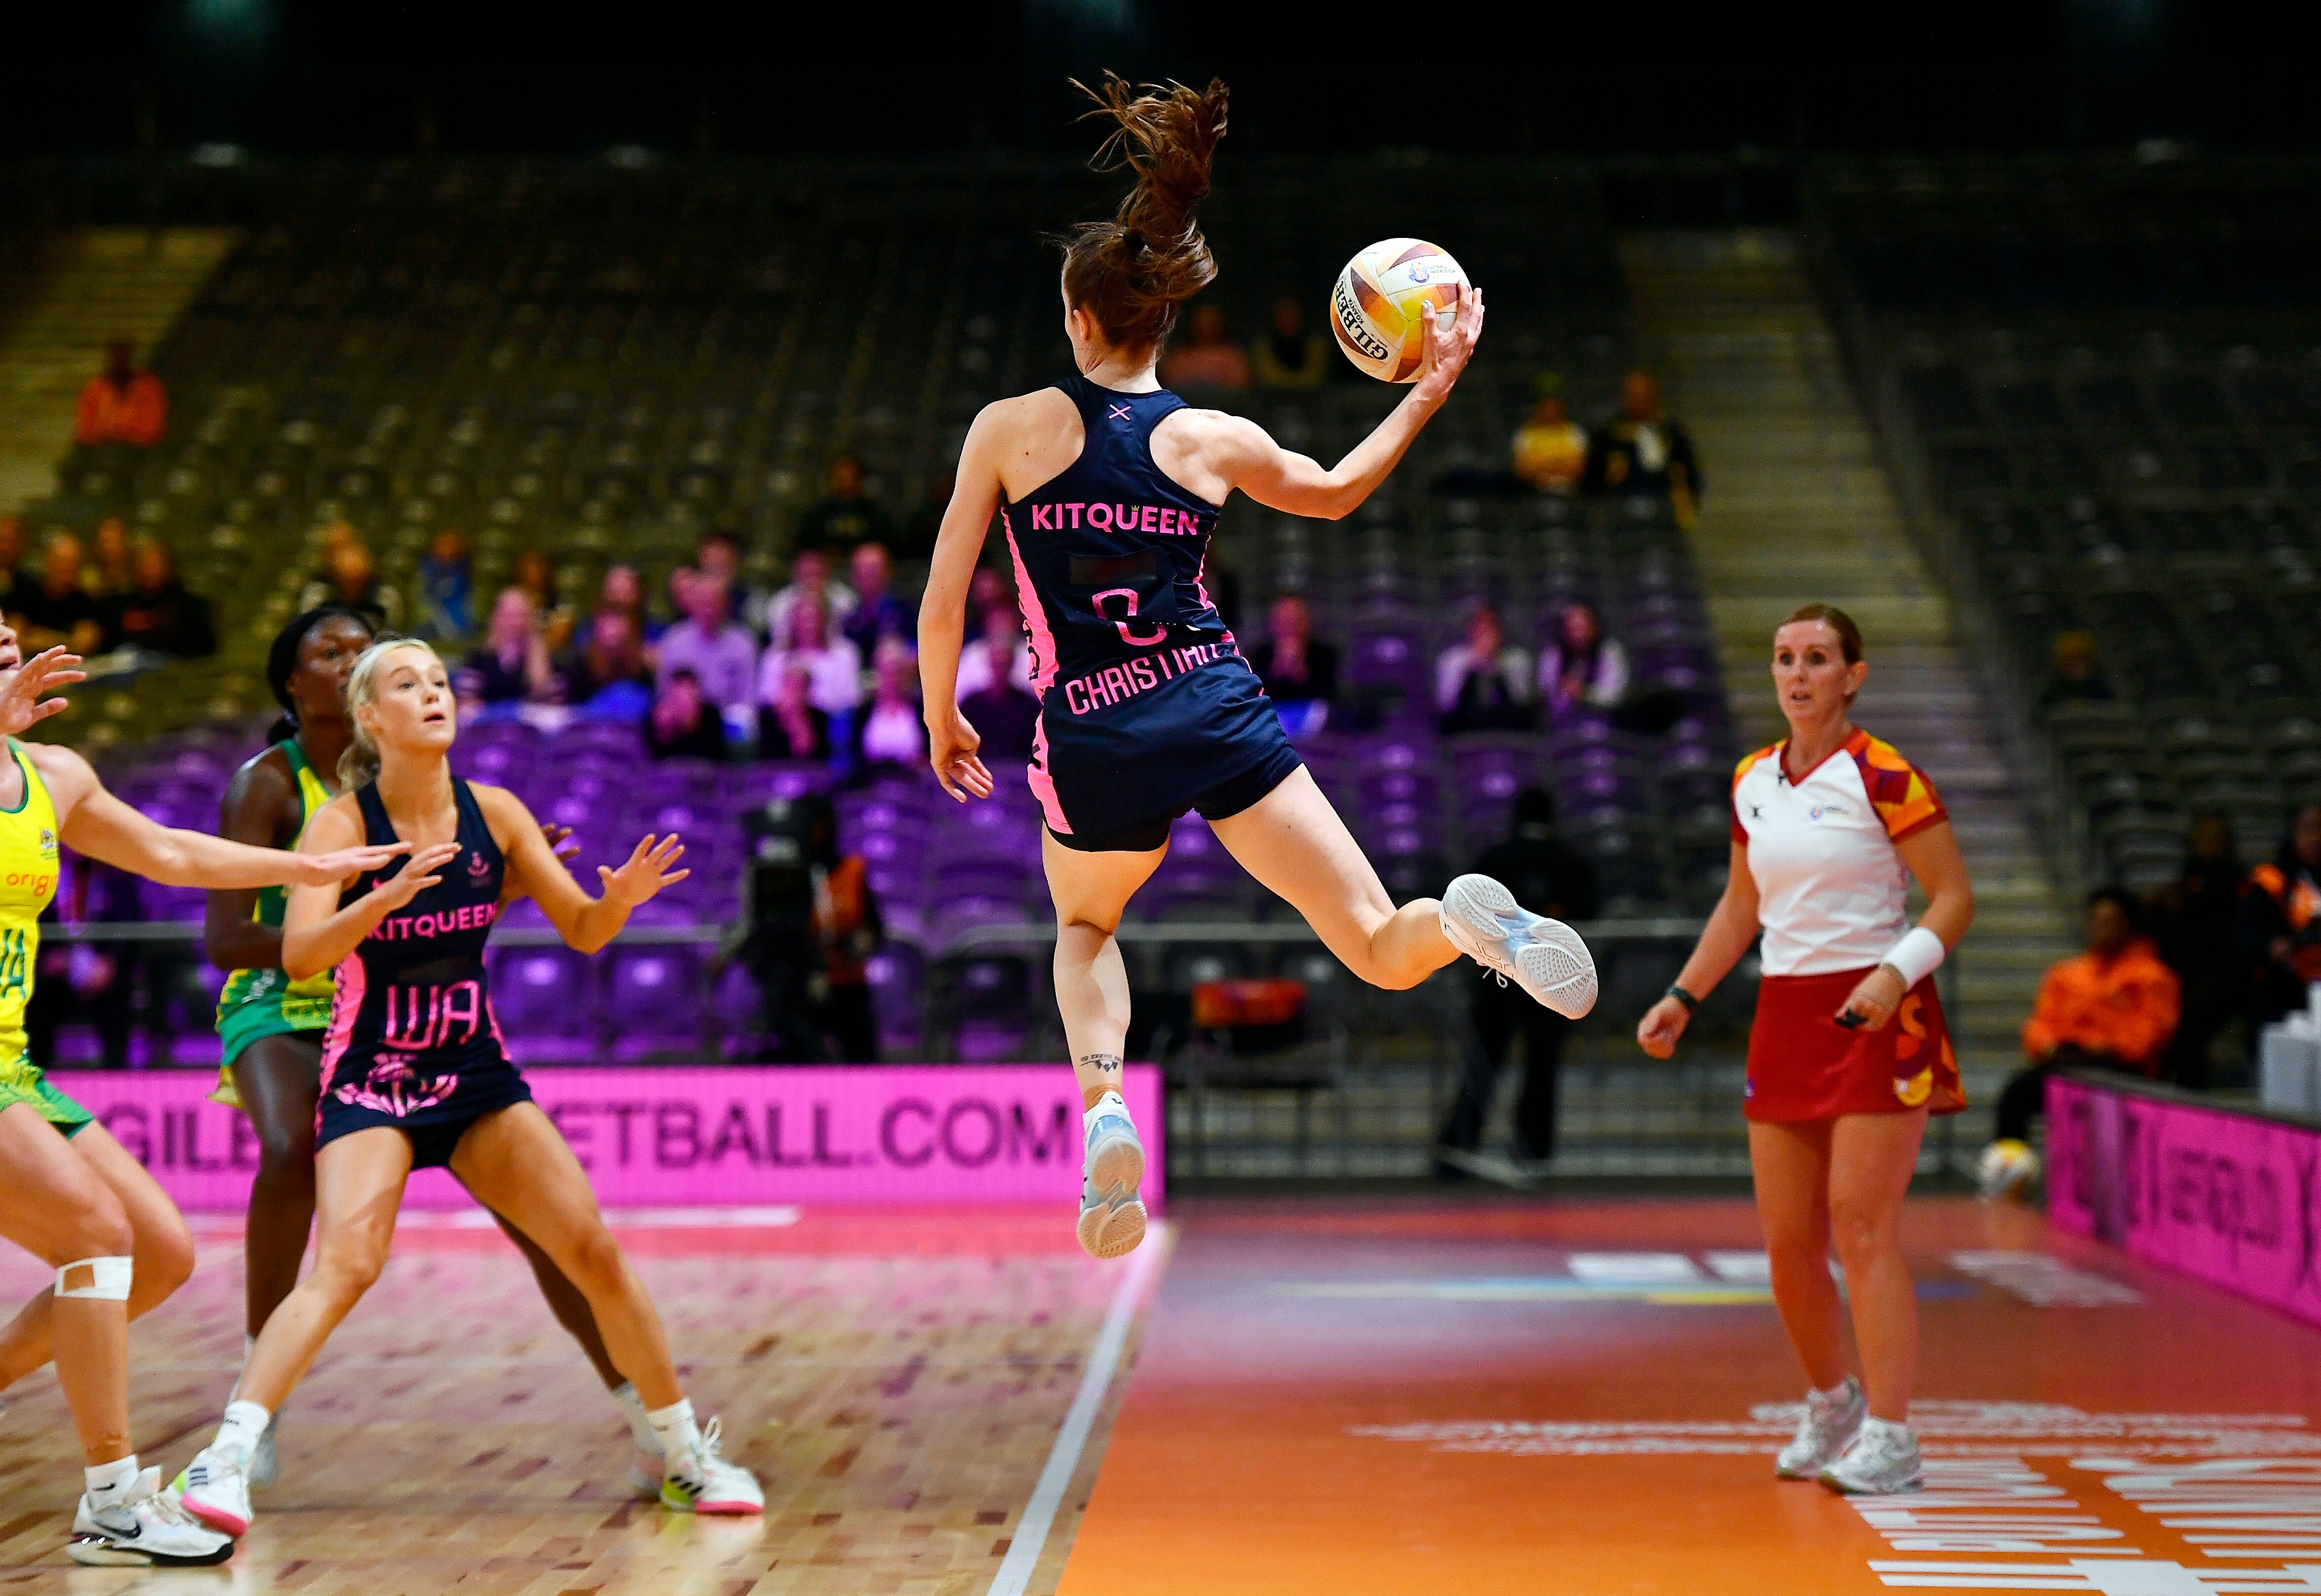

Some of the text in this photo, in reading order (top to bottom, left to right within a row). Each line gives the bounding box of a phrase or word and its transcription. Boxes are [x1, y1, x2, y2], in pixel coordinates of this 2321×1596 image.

[1032, 503, 1199, 535] KITQUEEN
[1092, 588, 1167, 646] C
[382, 979, 481, 1051] WA
